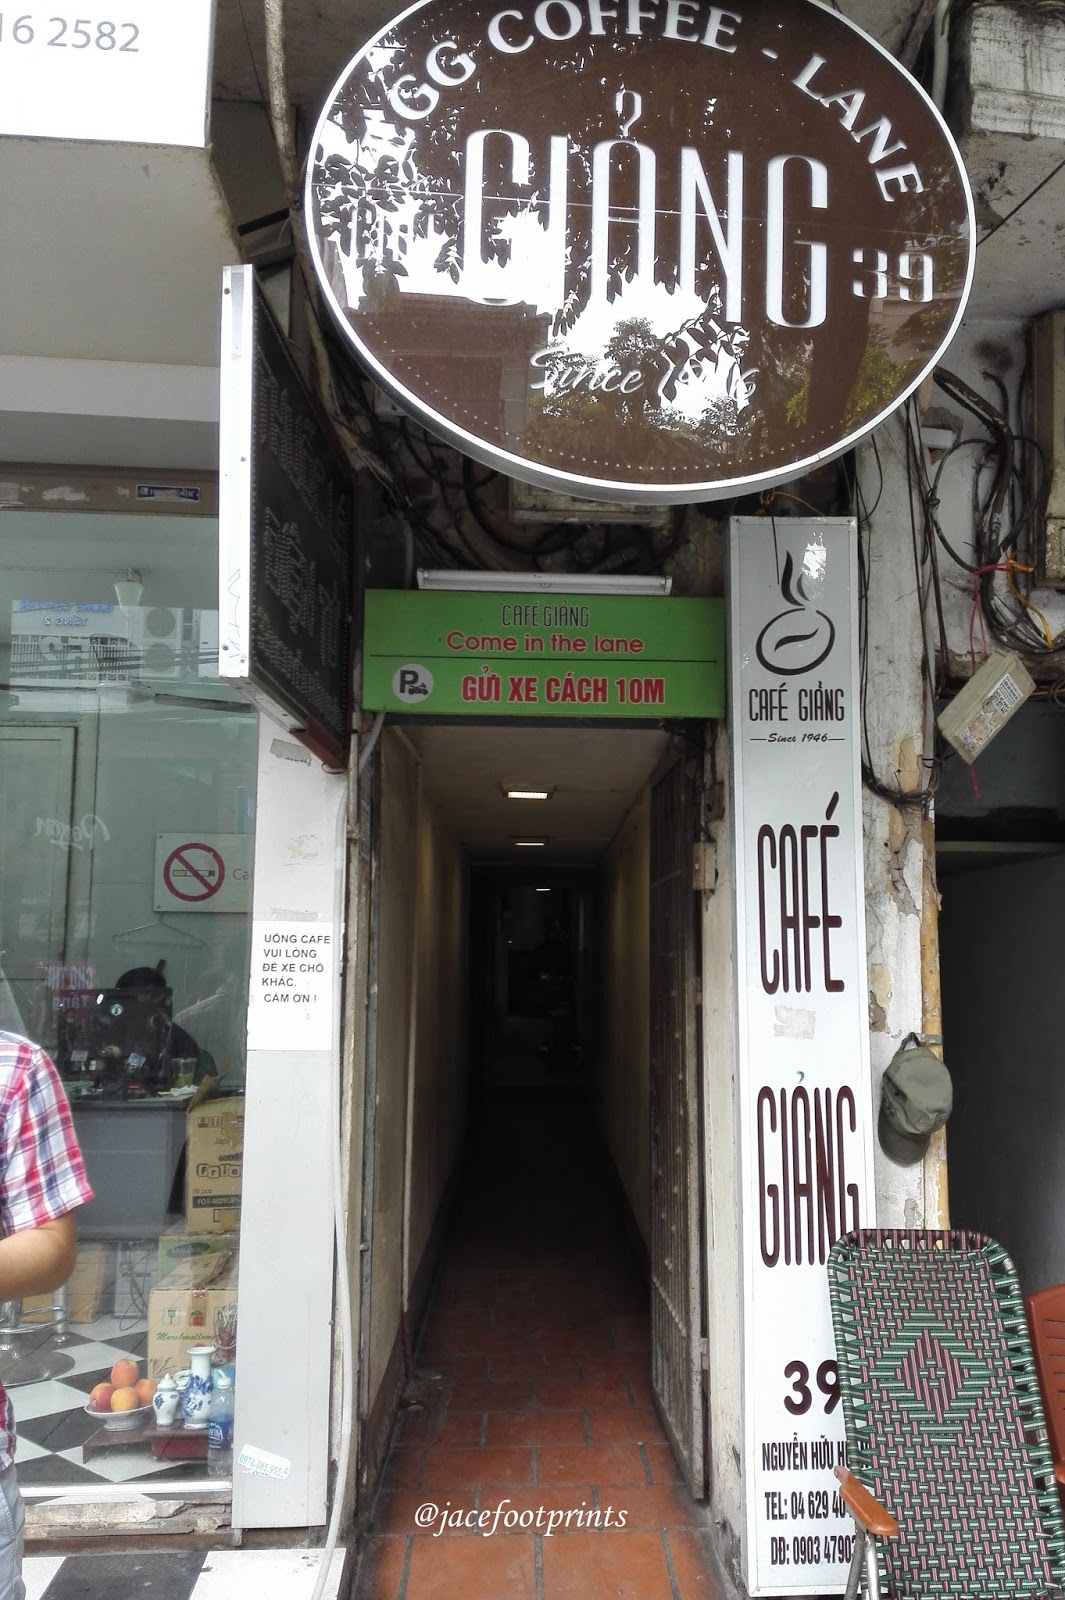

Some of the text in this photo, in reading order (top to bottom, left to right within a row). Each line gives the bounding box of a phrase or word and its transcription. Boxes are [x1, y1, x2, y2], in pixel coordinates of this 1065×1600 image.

[47, 17, 139, 52] 2582
[487, 0, 743, 54] COFFEE
[792, 53, 924, 203] LANE
[462, 89, 934, 329] GIẢNG 39
[502, 600, 590, 628] CAFÉ GIẢNG
[446, 631, 644, 654] Come in the lane
[508, 676, 538, 702] XE
[545, 672, 608, 703] CÁCH
[615, 677, 666, 704] 10M
[748, 681, 845, 722] CAFÉ GIẢNG
[767, 732, 829, 743] Since 1946
[232, 868, 252, 881] Ca
[757, 792, 845, 995] CAFÉ
[263, 948, 282, 958] VUI
[300, 934, 331, 944] CAFE
[281, 963, 296, 972] XE
[757, 1070, 859, 1268] GIẢNG
[784, 1359, 842, 1416] 39
[762, 1432, 808, 1471] NGUYỄN
[811, 1435, 834, 1469] HỮU
[764, 1492, 788, 1521] TEL:
[790, 1491, 805, 1520] 04
[808, 1490, 829, 1519] 629
[770, 1536, 790, 1565] DĐ:
[793, 1535, 821, 1565] 0903
